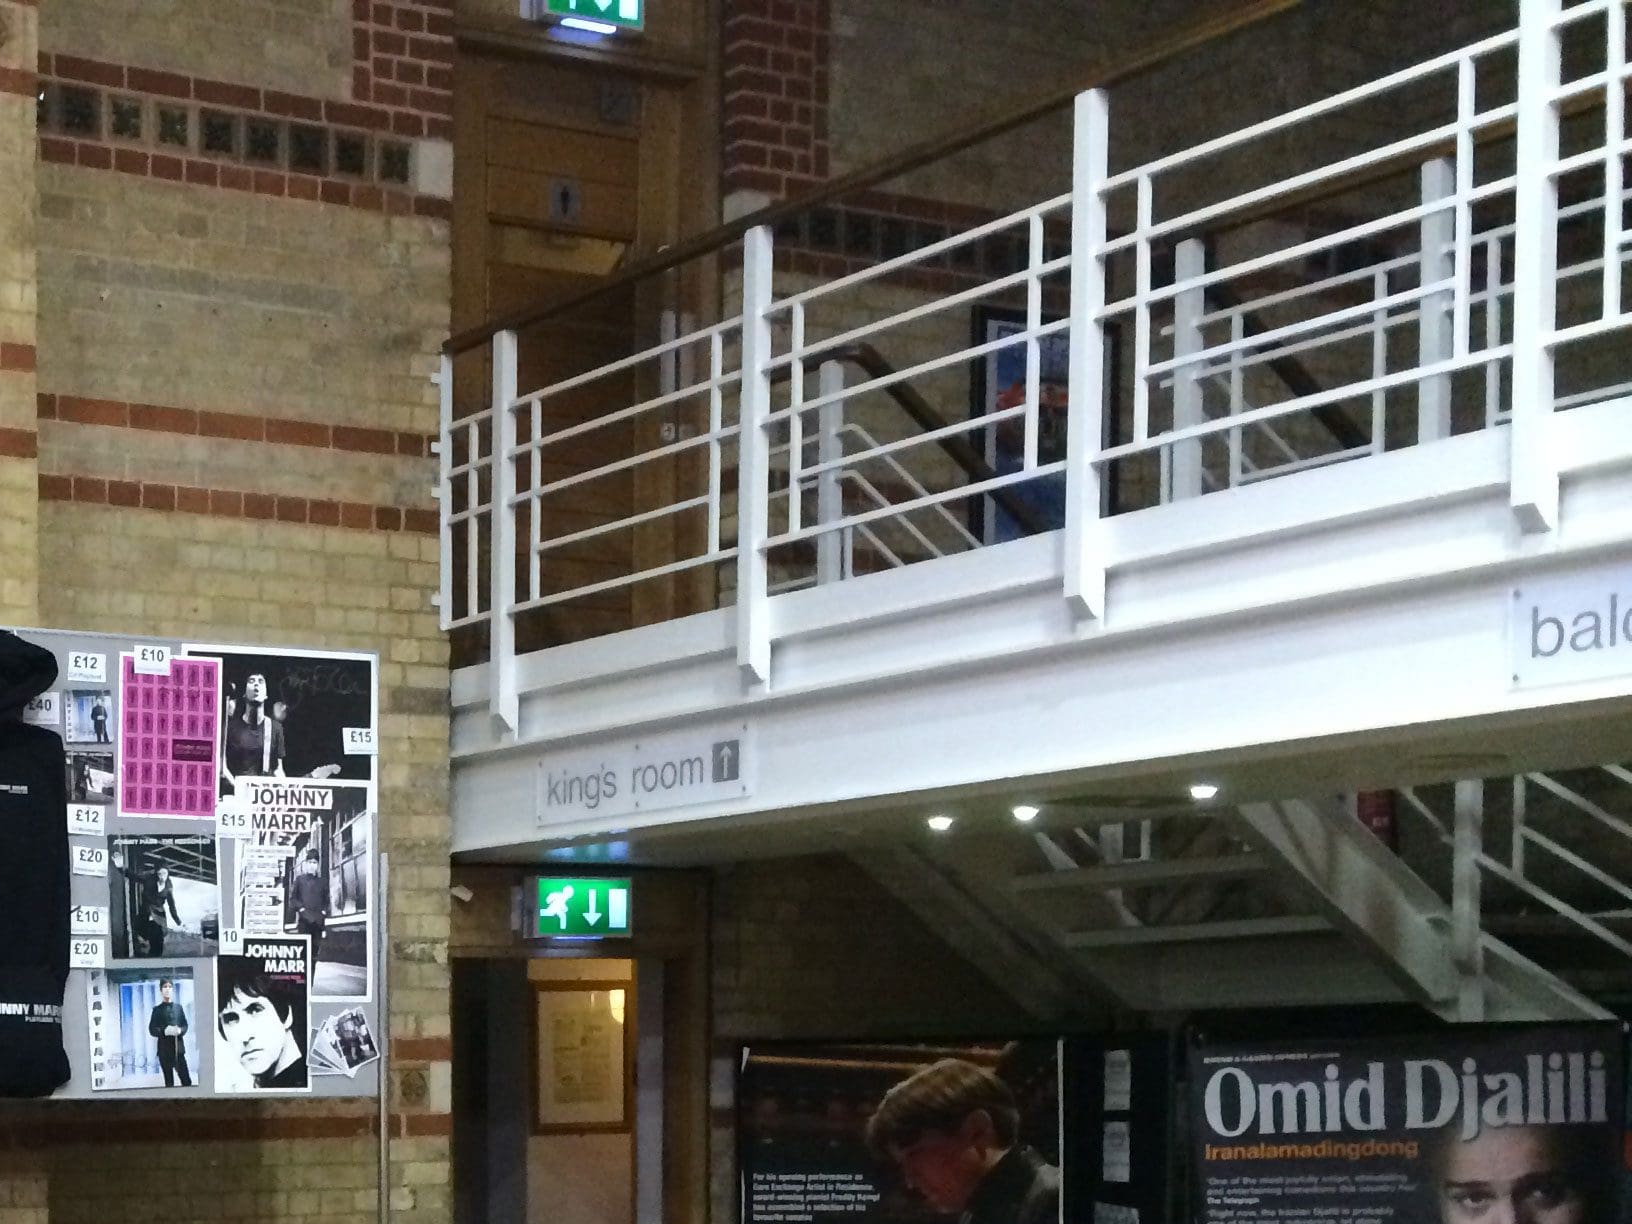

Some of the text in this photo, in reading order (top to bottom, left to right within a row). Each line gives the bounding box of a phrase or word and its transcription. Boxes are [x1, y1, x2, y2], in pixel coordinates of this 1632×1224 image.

[74, 655, 97, 669] £12
[141, 649, 164, 662] £10
[28, 699, 52, 711] £40
[350, 731, 372, 743] £15
[546, 756, 704, 809] king's room
[252, 789, 329, 807] JOHNNY
[76, 809, 99, 823] £12
[221, 814, 246, 827] £15
[251, 813, 307, 830] MARR
[79, 849, 102, 863] £20
[76, 910, 99, 923] £10
[74, 942, 98, 955] £20
[245, 944, 304, 959] JOHNNY
[264, 959, 305, 973] MARR
[1204, 1061, 1386, 1137] Omid
[1405, 1050, 1608, 1142] Djalili
